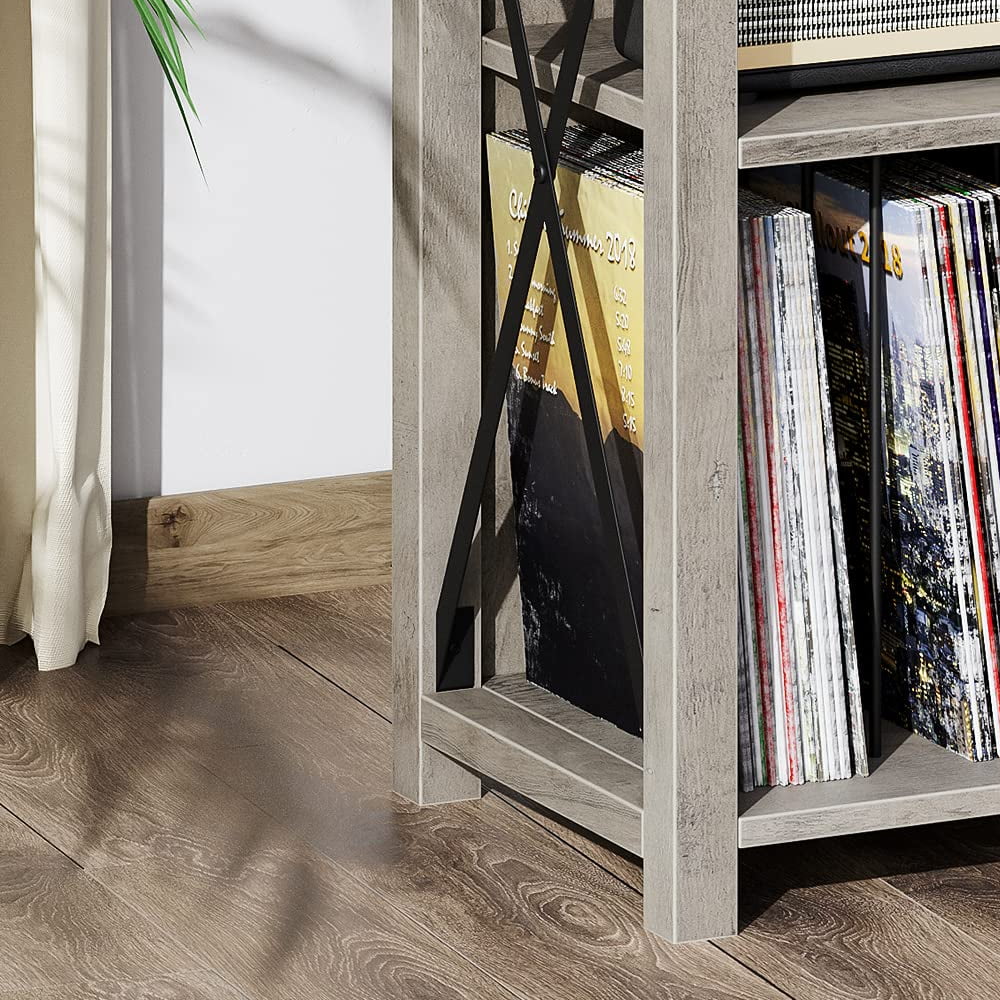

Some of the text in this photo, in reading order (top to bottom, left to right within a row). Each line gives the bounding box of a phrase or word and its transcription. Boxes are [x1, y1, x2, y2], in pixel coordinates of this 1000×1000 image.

[545, 209, 604, 254] ummer
[606, 231, 636, 270] 2018
[858, 230, 903, 279] 218
